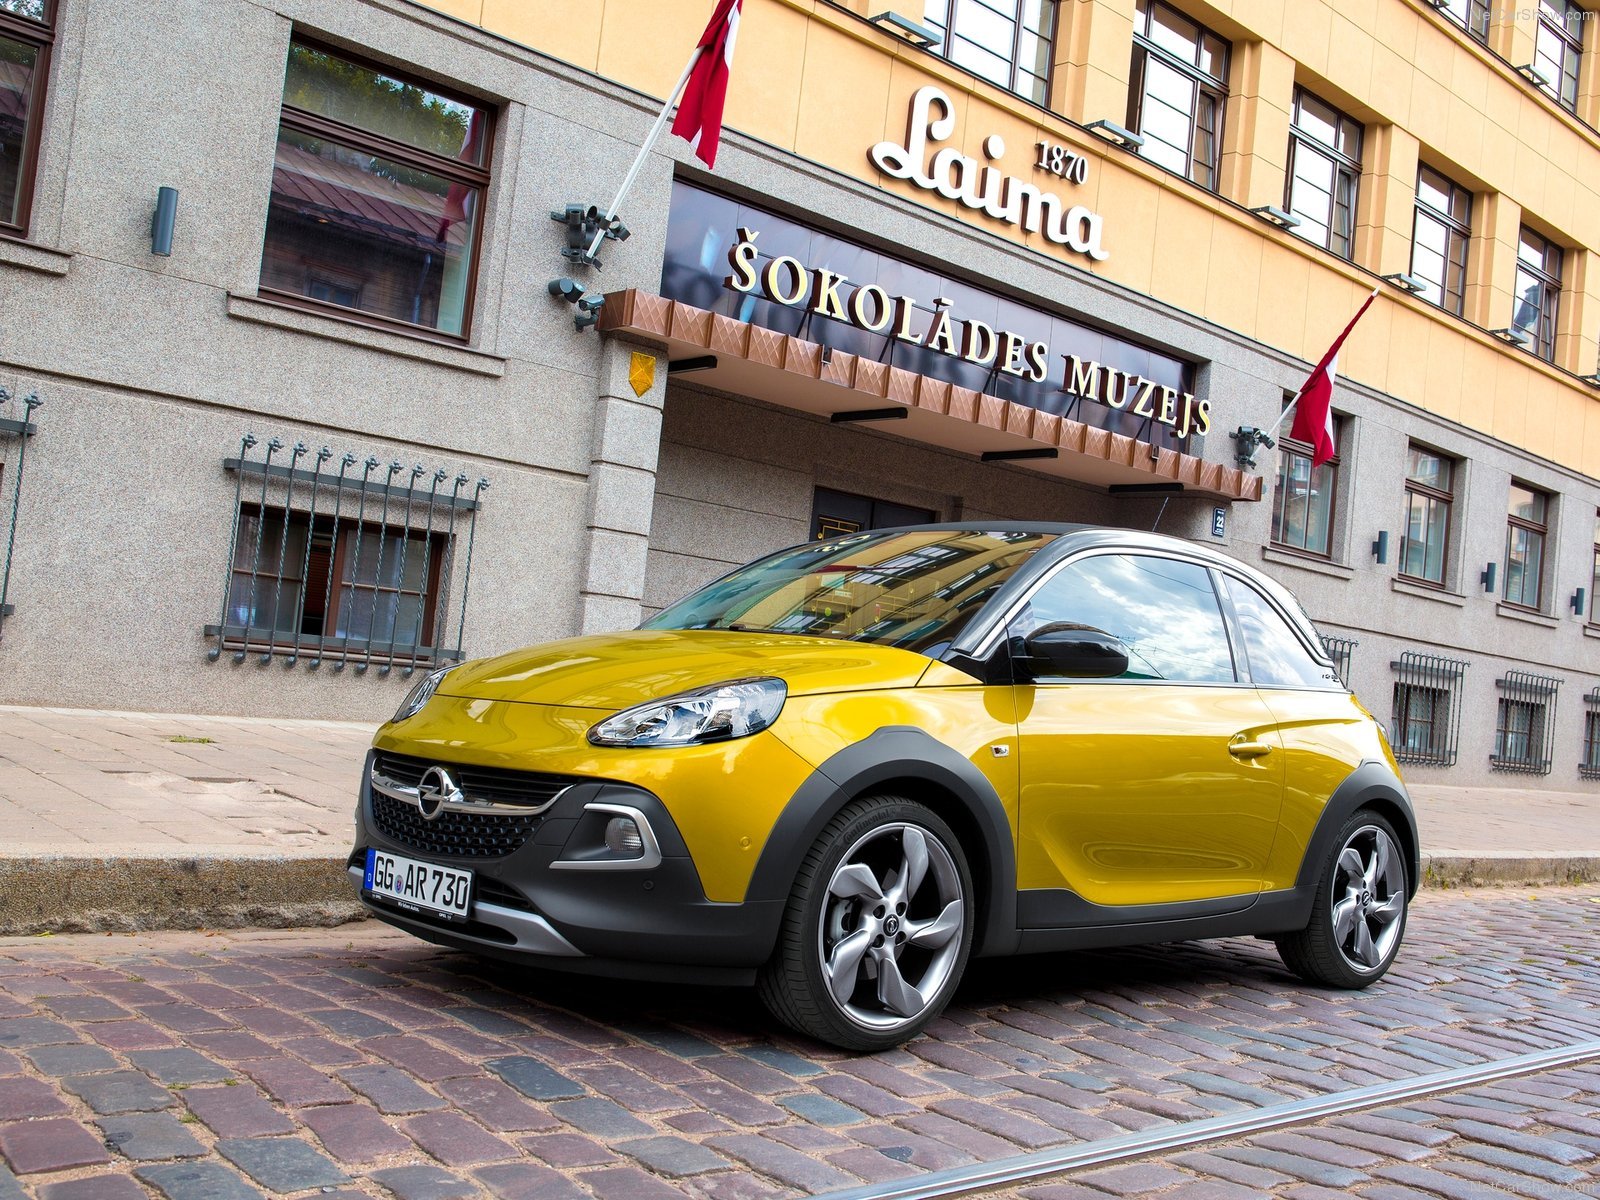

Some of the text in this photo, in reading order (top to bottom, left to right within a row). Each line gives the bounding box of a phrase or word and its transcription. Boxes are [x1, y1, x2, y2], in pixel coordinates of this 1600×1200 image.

[867, 85, 1109, 261] Laima
[1035, 139, 1089, 185] 1870
[725, 227, 1212, 439] ŠOKOLĀDES MUZEJS
[1216, 516, 1224, 528] 22
[375, 856, 469, 910] GG AR 730
